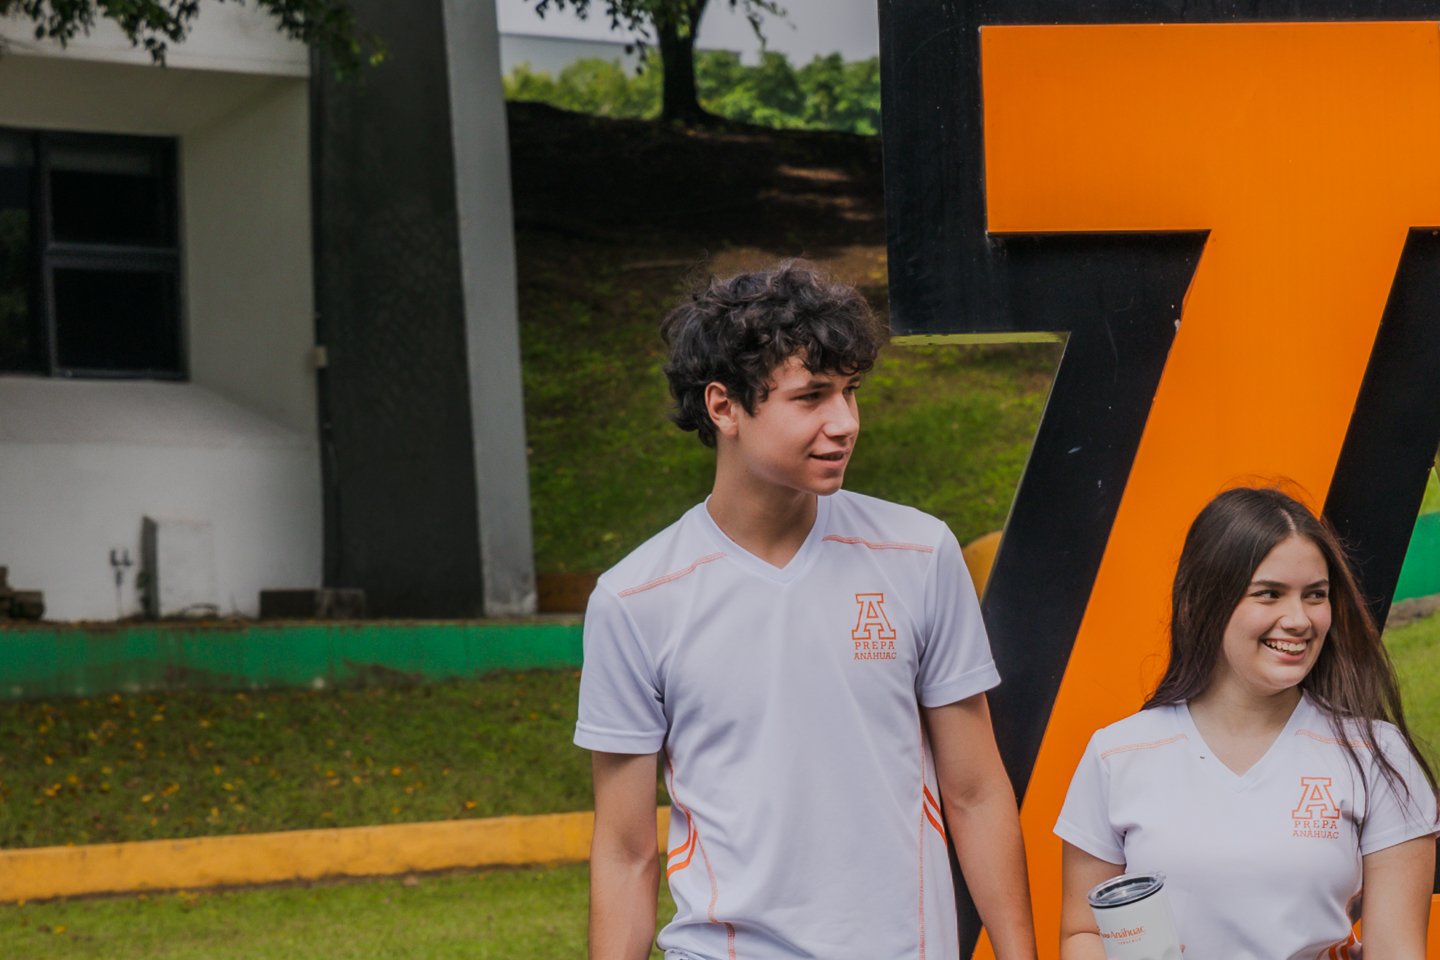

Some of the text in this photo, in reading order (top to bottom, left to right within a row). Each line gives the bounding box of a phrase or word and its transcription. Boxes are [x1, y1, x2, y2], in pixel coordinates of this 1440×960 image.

[852, 593, 896, 640] A
[855, 641, 895, 650] PREPA
[1291, 776, 1340, 819] A
[1294, 820, 1338, 830] PREPA
